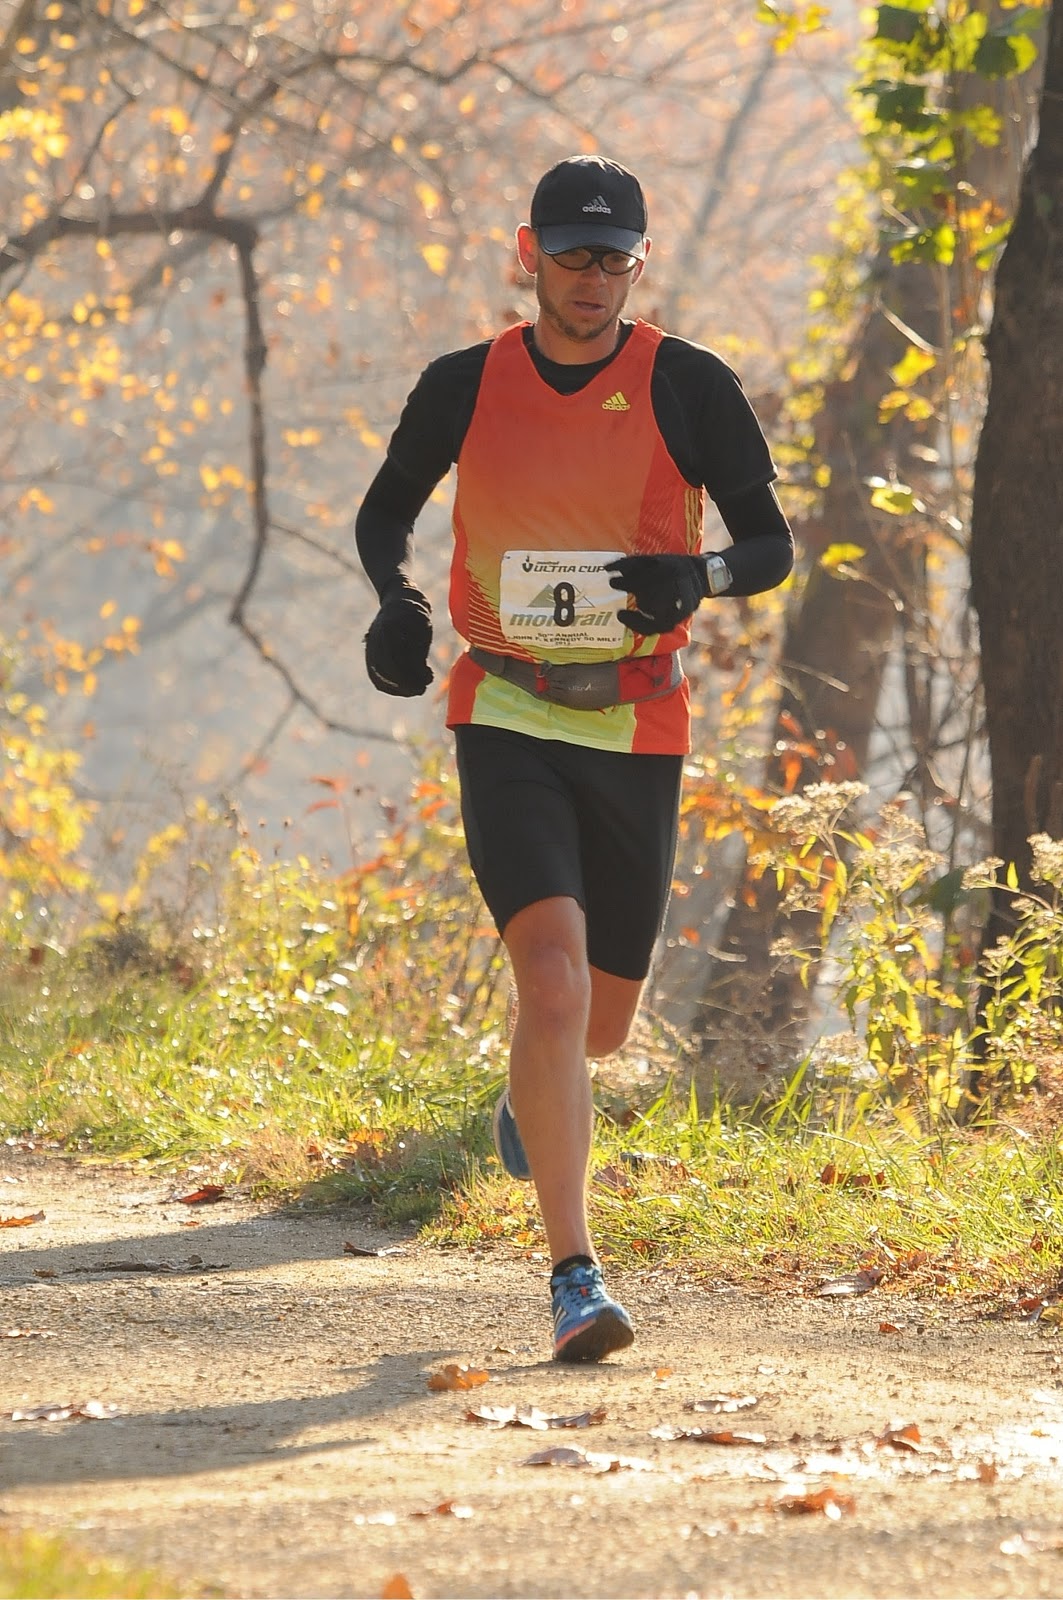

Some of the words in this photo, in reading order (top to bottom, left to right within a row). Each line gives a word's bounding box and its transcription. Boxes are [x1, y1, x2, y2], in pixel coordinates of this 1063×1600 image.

[582, 203, 612, 214] adidas
[601, 402, 631, 411] adidas
[578, 565, 606, 573] CUP
[553, 581, 576, 627] 8
